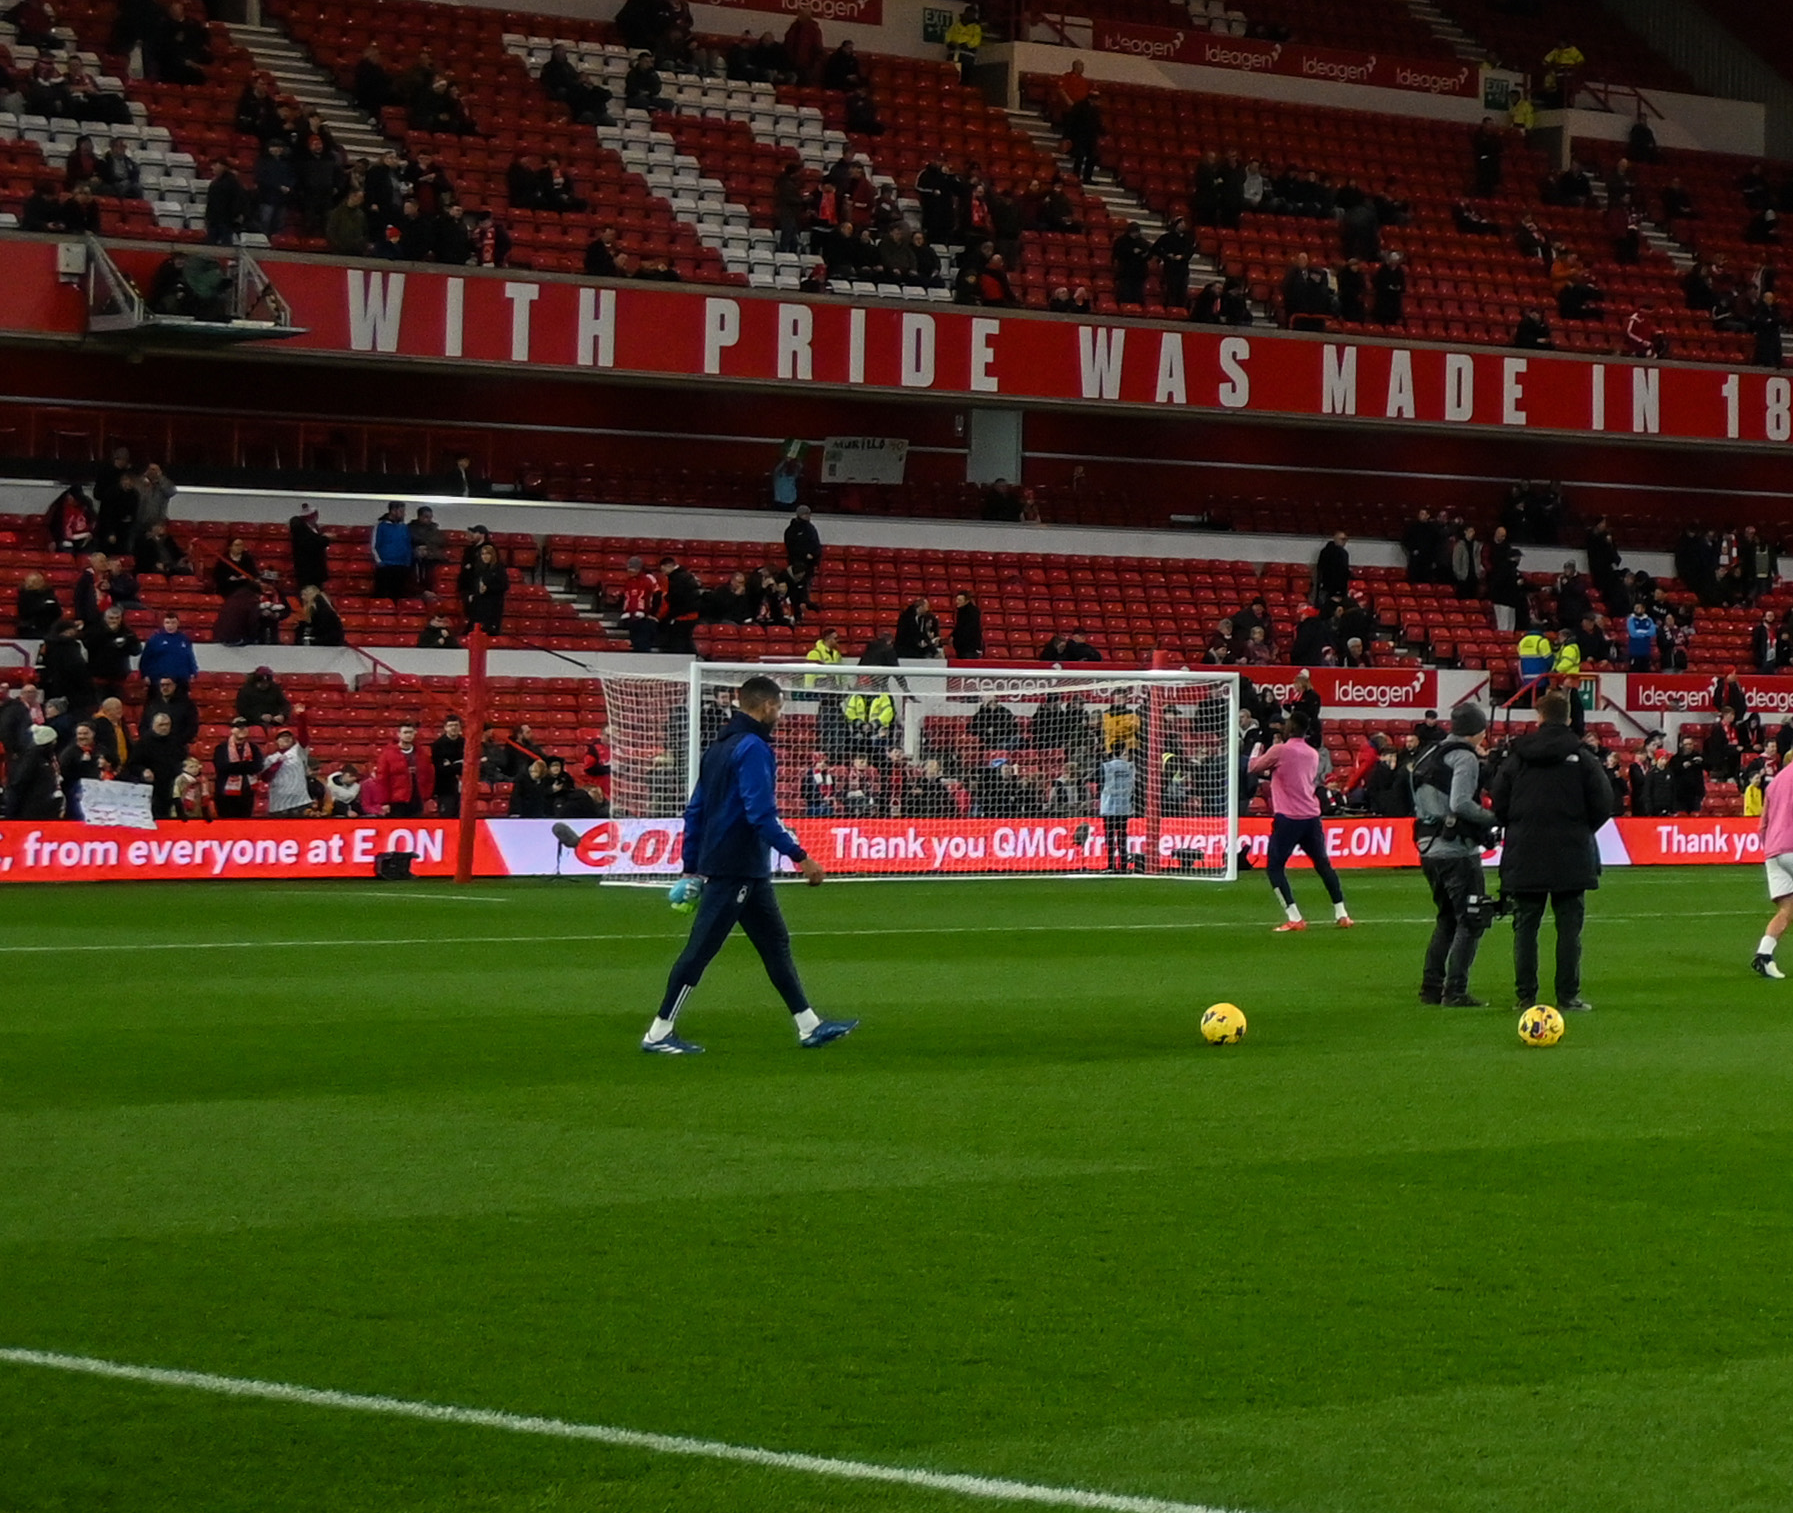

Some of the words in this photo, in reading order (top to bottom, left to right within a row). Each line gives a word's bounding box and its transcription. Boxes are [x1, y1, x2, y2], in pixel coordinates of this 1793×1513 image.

[924, 10, 952, 25] EXIT
[1205, 44, 1272, 71] Ideagen
[1302, 55, 1368, 82] Ideagen
[1396, 67, 1460, 93] Ideagen
[347, 269, 615, 368] WITH
[704, 298, 1000, 392] PRIDE
[1078, 326, 1251, 407] WAS
[1322, 343, 1527, 427] MADE
[1590, 363, 1661, 435] IN
[1335, 680, 1413, 706] Ideagen
[24, 831, 118, 866] from
[128, 838, 299, 875] everyone
[307, 834, 343, 864] at
[831, 826, 925, 860] Thank
[933, 835, 985, 868] you
[993, 826, 1075, 863] QMC,
[1326, 826, 1393, 857] E.ON
[1657, 825, 1729, 853] Thank
[1733, 831, 1763, 861] yo
